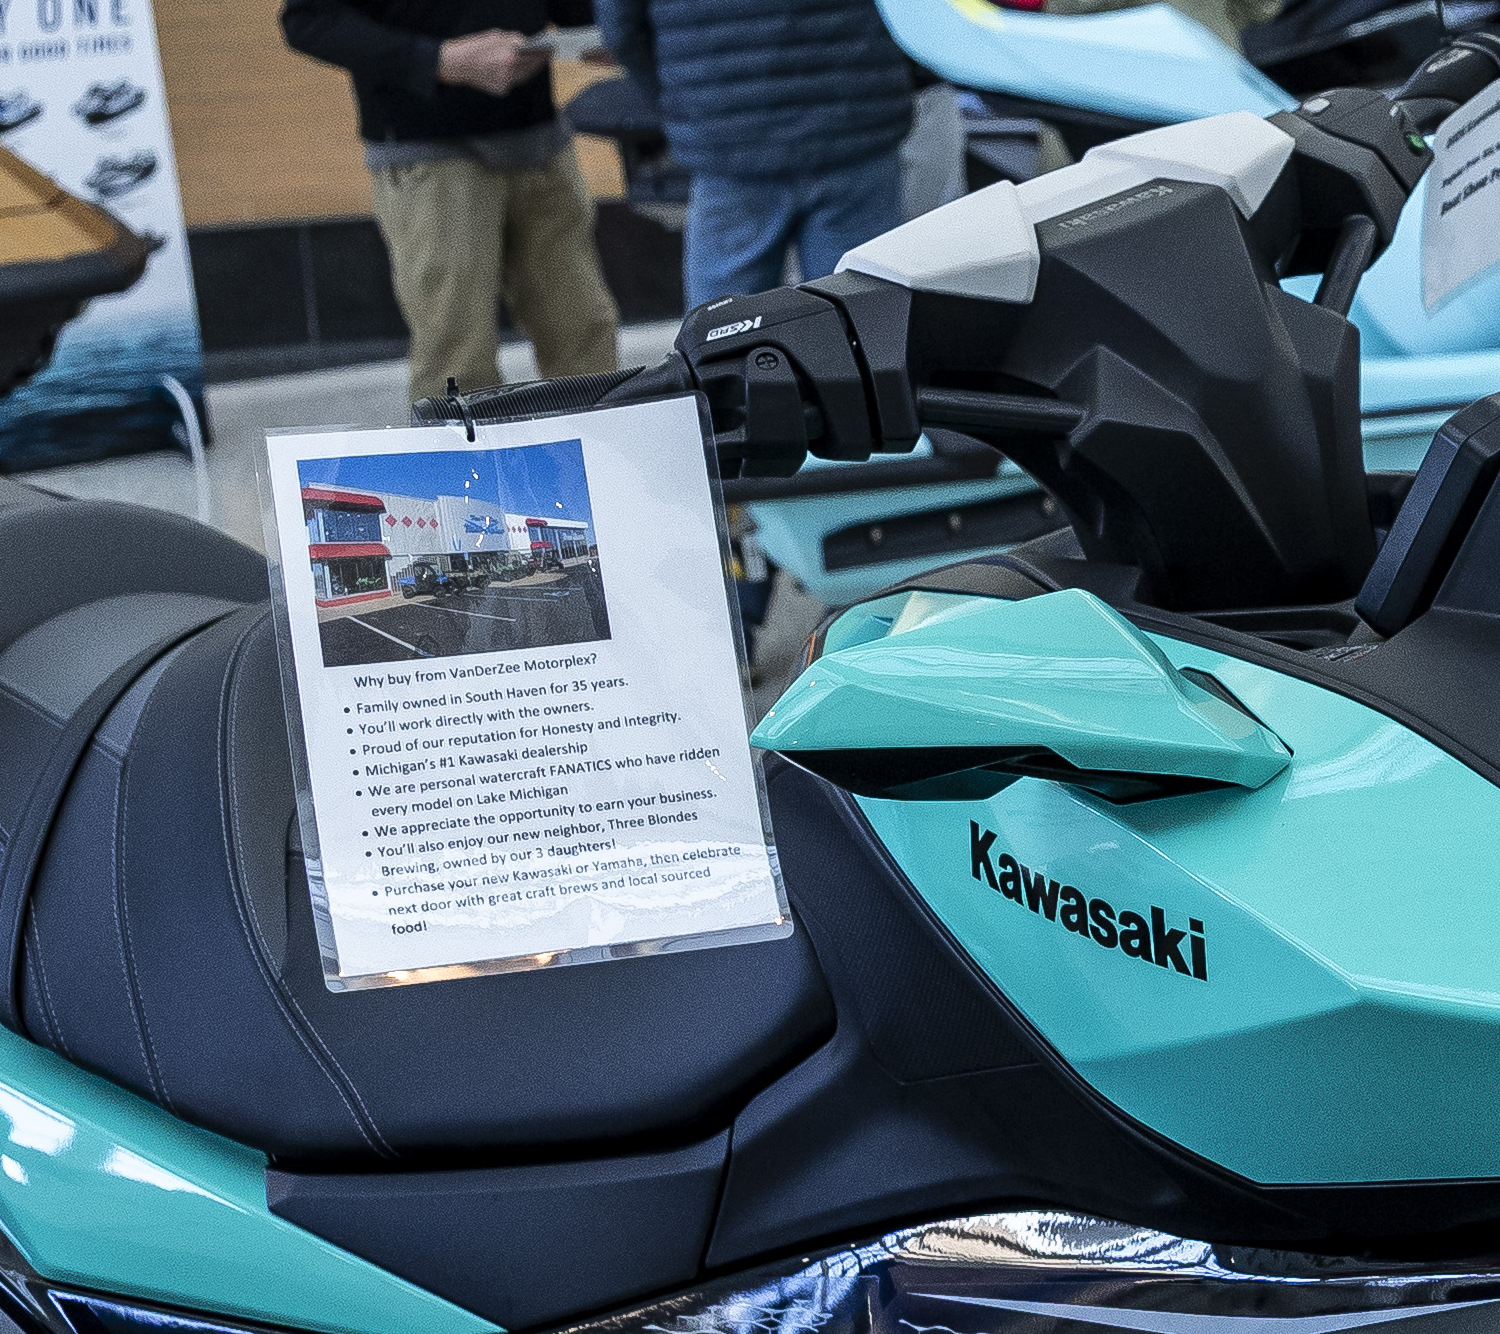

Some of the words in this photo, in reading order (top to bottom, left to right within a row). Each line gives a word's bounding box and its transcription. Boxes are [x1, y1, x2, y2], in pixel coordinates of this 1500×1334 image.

[353, 675, 385, 689] Why
[387, 673, 412, 686] buy
[414, 670, 447, 683] from
[448, 662, 521, 679] VanDerZee
[523, 652, 598, 672] Motorplex?
[356, 699, 399, 715] Family
[401, 694, 447, 710] owned
[449, 693, 463, 705] in
[464, 688, 504, 704] South
[505, 686, 547, 700] Haven
[549, 682, 569, 695] for
[571, 679, 588, 693] 35
[590, 677, 629, 693] years.
[398, 716, 433, 731] work
[435, 711, 484, 728] directly
[486, 707, 516, 722] with
[517, 706, 540, 719] the
[543, 702, 595, 716] owners.
[362, 740, 402, 756] Proud
[405, 737, 419, 752] of
[421, 738, 445, 750] our
[447, 730, 517, 748] reputation
[519, 726, 539, 739] for
[541, 721, 594, 737] Honesty
[597, 716, 622, 731] and
[623, 711, 682, 728] Integrity.
[367, 784, 391, 798] We
[394, 783, 416, 795] are
[419, 773, 477, 794] personal
[478, 766, 547, 785] watercraft
[549, 758, 613, 777] FANATICS
[614, 756, 643, 769] who
[645, 753, 676, 766] have
[678, 747, 721, 762] ridden
[439, 756, 456, 769] #1
[458, 748, 519, 767] Kawasaki
[521, 741, 589, 760] dealership
[371, 804, 408, 817] every
[411, 796, 453, 813] model
[455, 796, 474, 808] on
[476, 791, 507, 805] Lake
[509, 785, 569, 801] Michigan
[373, 824, 398, 838] We
[400, 817, 471, 836] appreciate
[473, 813, 496, 826] the
[498, 804, 576, 825] opportunity
[578, 803, 593, 814] to
[595, 799, 625, 812] earn
[626, 795, 657, 811] your
[658, 789, 718, 805] business.
[418, 840, 445, 854] also
[447, 836, 484, 851] enjoy
[486, 833, 510, 845] our
[512, 830, 541, 842] new
[543, 822, 606, 839] neighbor,
[606, 818, 645, 831] Three
[647, 810, 699, 826] Blondes
[381, 862, 440, 877] Brewing,
[442, 853, 488, 870] owned
[490, 852, 507, 866] by
[509, 850, 533, 862] our
[535, 846, 544, 859] 3
[547, 837, 616, 857] daughters!
[384, 881, 445, 897] Purchase
[447, 877, 478, 892] your
[481, 873, 510, 886] new
[512, 864, 573, 882] Kawasaki
[575, 864, 589, 874] or
[591, 857, 648, 872] Yamaha,
[649, 853, 680, 866] then
[682, 846, 741, 861] celebrate
[388, 903, 418, 916] next
[420, 900, 452, 913] door
[455, 894, 485, 908] with
[487, 890, 523, 907] great
[525, 885, 556, 900] craft
[558, 882, 599, 896] brews
[601, 876, 626, 890] and
[628, 872, 658, 887] local
[661, 866, 711, 883] sourced
[969, 819, 1209, 983] Kawasaki
[391, 920, 428, 935] food!
